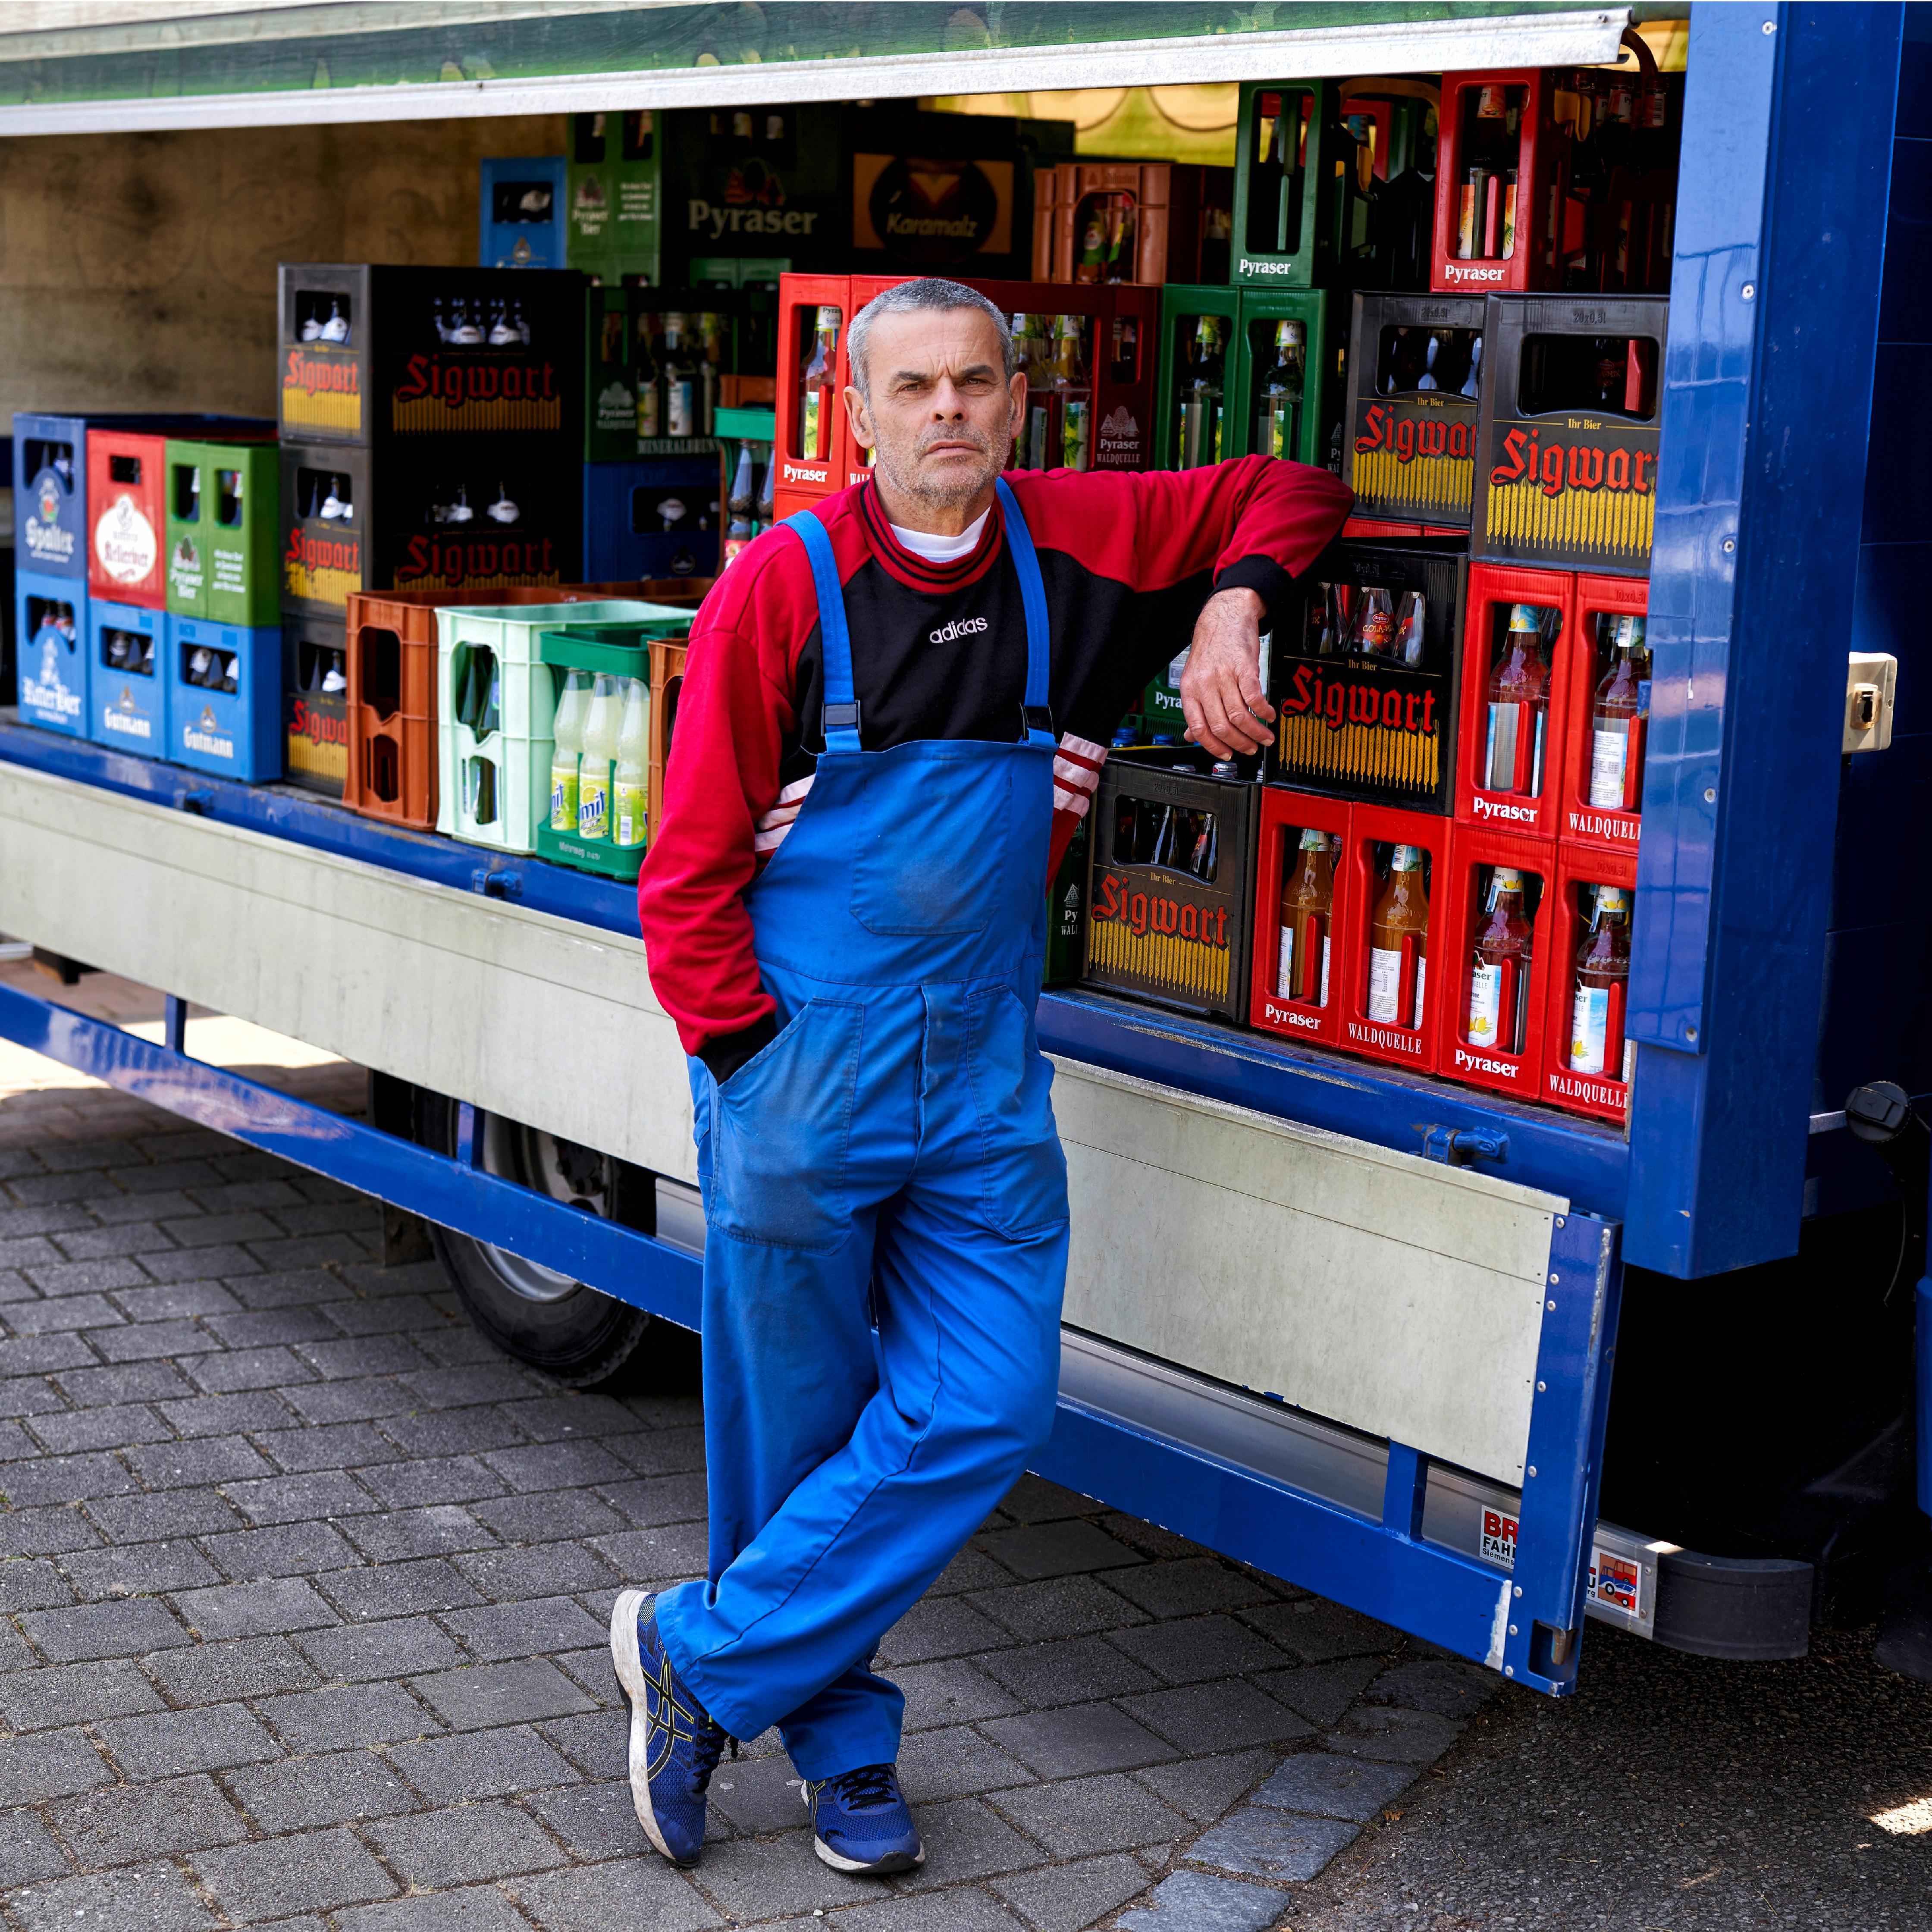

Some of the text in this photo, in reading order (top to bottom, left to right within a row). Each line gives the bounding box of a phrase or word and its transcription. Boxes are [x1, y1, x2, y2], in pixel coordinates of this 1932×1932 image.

[688, 199, 819, 240] Pyraser
[886, 212, 979, 238] Karamalz
[1239, 259, 1292, 277] Pyraser
[1445, 265, 1505, 283] Pyraser
[283, 350, 358, 395] Sigwart
[396, 352, 554, 407] Sigwart
[1417, 397, 1444, 407] Ihr Bier
[1568, 418, 1601, 430] Ihr Bier
[1100, 438, 1140, 452] Pyraser
[1097, 453, 1141, 464] WALDQUELLE
[1490, 428, 1659, 496] Sigwar
[784, 464, 828, 483] Pyraser
[285, 527, 359, 571] Sigwart
[397, 533, 554, 584] Sigwart
[929, 617, 988, 643] adidas
[1348, 659, 1377, 671] Ihr Bier
[1282, 664, 1436, 732] Sigwart
[104, 706, 151, 738] Gutmann
[183, 725, 233, 759] Gutmann
[1473, 796, 1538, 823] Pyraser
[1150, 872, 1176, 885] Ihr Bier
[1091, 873, 1227, 946] Sigwart
[1265, 1004, 1321, 1030] Pyraser
[1348, 1022, 1422, 1054] WALDQUELLE
[1455, 1049, 1519, 1078] Pyraser
[1482, 1548, 1515, 1565] Siemens
